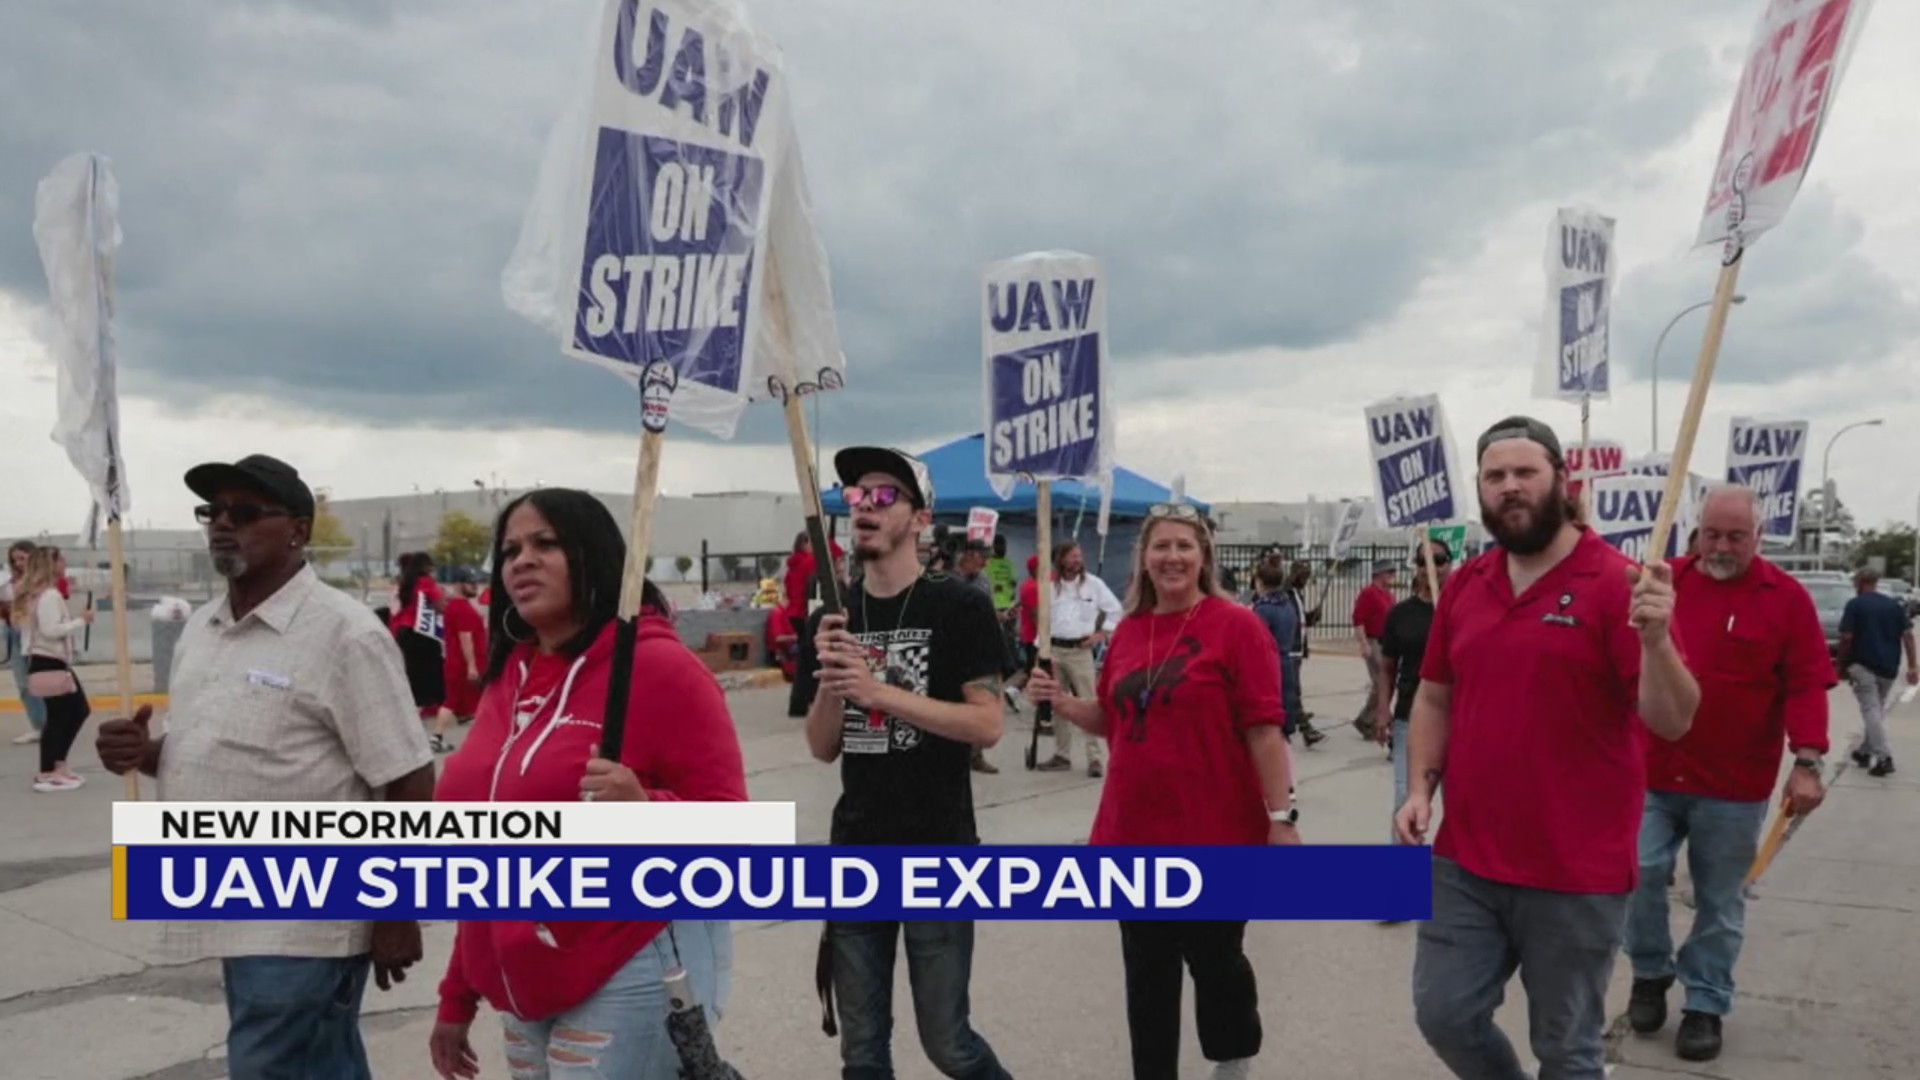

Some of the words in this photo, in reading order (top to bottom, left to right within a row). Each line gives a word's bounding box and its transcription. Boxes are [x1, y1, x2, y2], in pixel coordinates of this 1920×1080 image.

[614, 0, 770, 148] UAW
[650, 161, 715, 243] ON
[586, 252, 748, 338] STRIKE
[987, 277, 1095, 333] UAW
[1022, 350, 1062, 406] ON
[993, 393, 1095, 467] STRIKE
[1371, 405, 1434, 445] UAW
[1733, 426, 1803, 456] UAW
[1400, 450, 1426, 485] ON
[1566, 447, 1622, 471] UAW
[1750, 466, 1777, 494] ON
[1388, 471, 1449, 525] STRIKE
